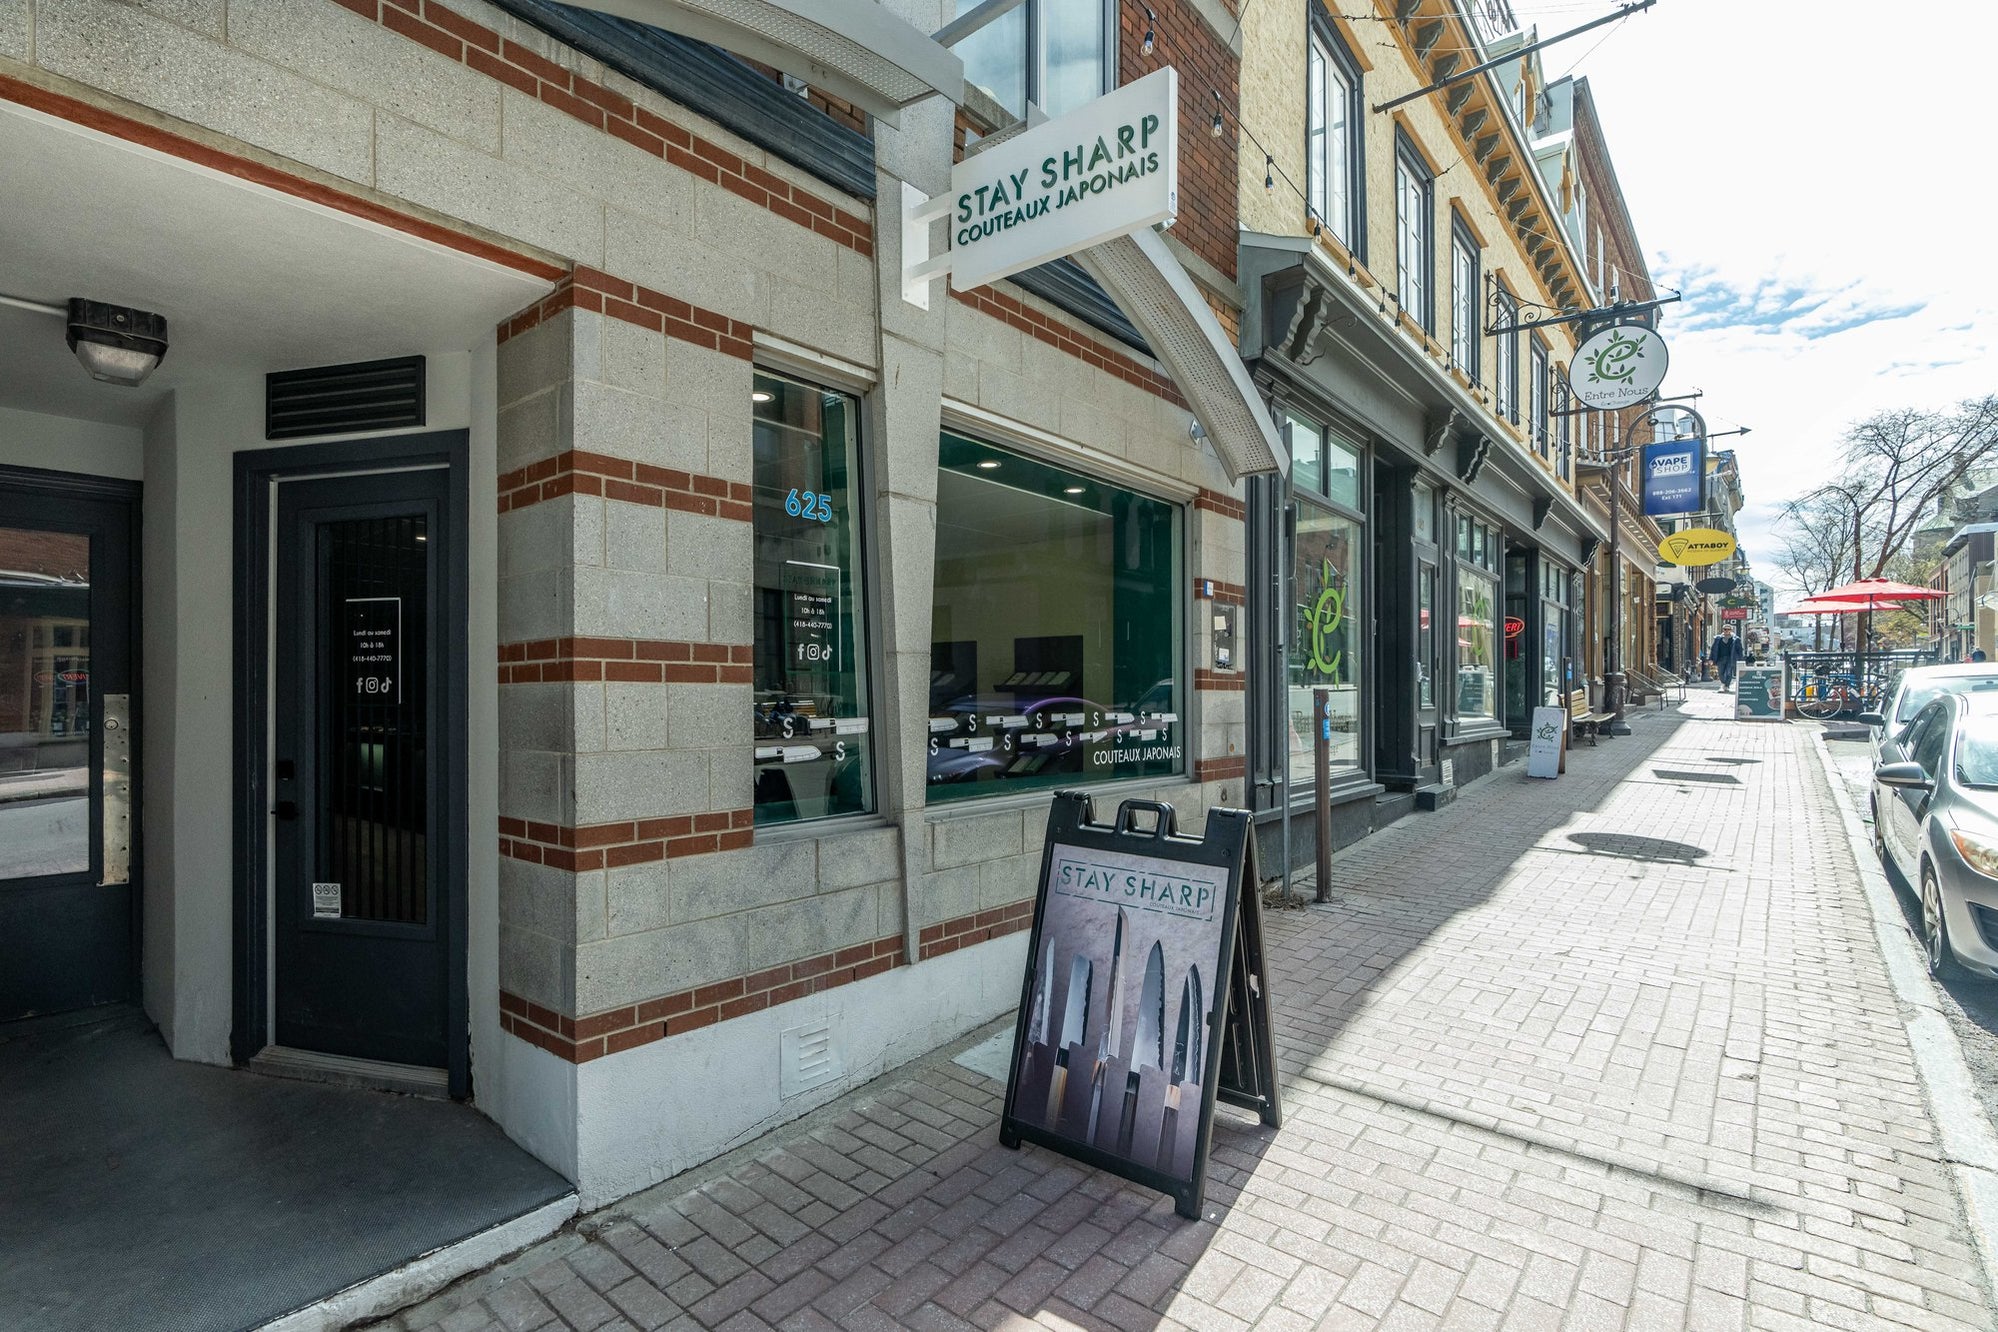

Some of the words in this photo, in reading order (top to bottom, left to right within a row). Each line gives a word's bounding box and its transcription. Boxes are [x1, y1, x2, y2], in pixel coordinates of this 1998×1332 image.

[958, 168, 1029, 223] STAY
[1041, 114, 1160, 189] SHARP
[957, 195, 1051, 246] COUTEAUX
[1056, 152, 1159, 209] JAPONAIS
[1584, 391, 1615, 401] Entre
[1618, 387, 1649, 397] Nous
[1656, 465, 1688, 473] SHOP
[1657, 456, 1688, 466] VAPE
[785, 488, 832, 522] 625
[1093, 748, 1140, 766] COUTEAUX
[1142, 745, 1181, 762] JAPONAIS
[1060, 866, 1116, 892] STAY
[1124, 876, 1210, 908] SHARP
